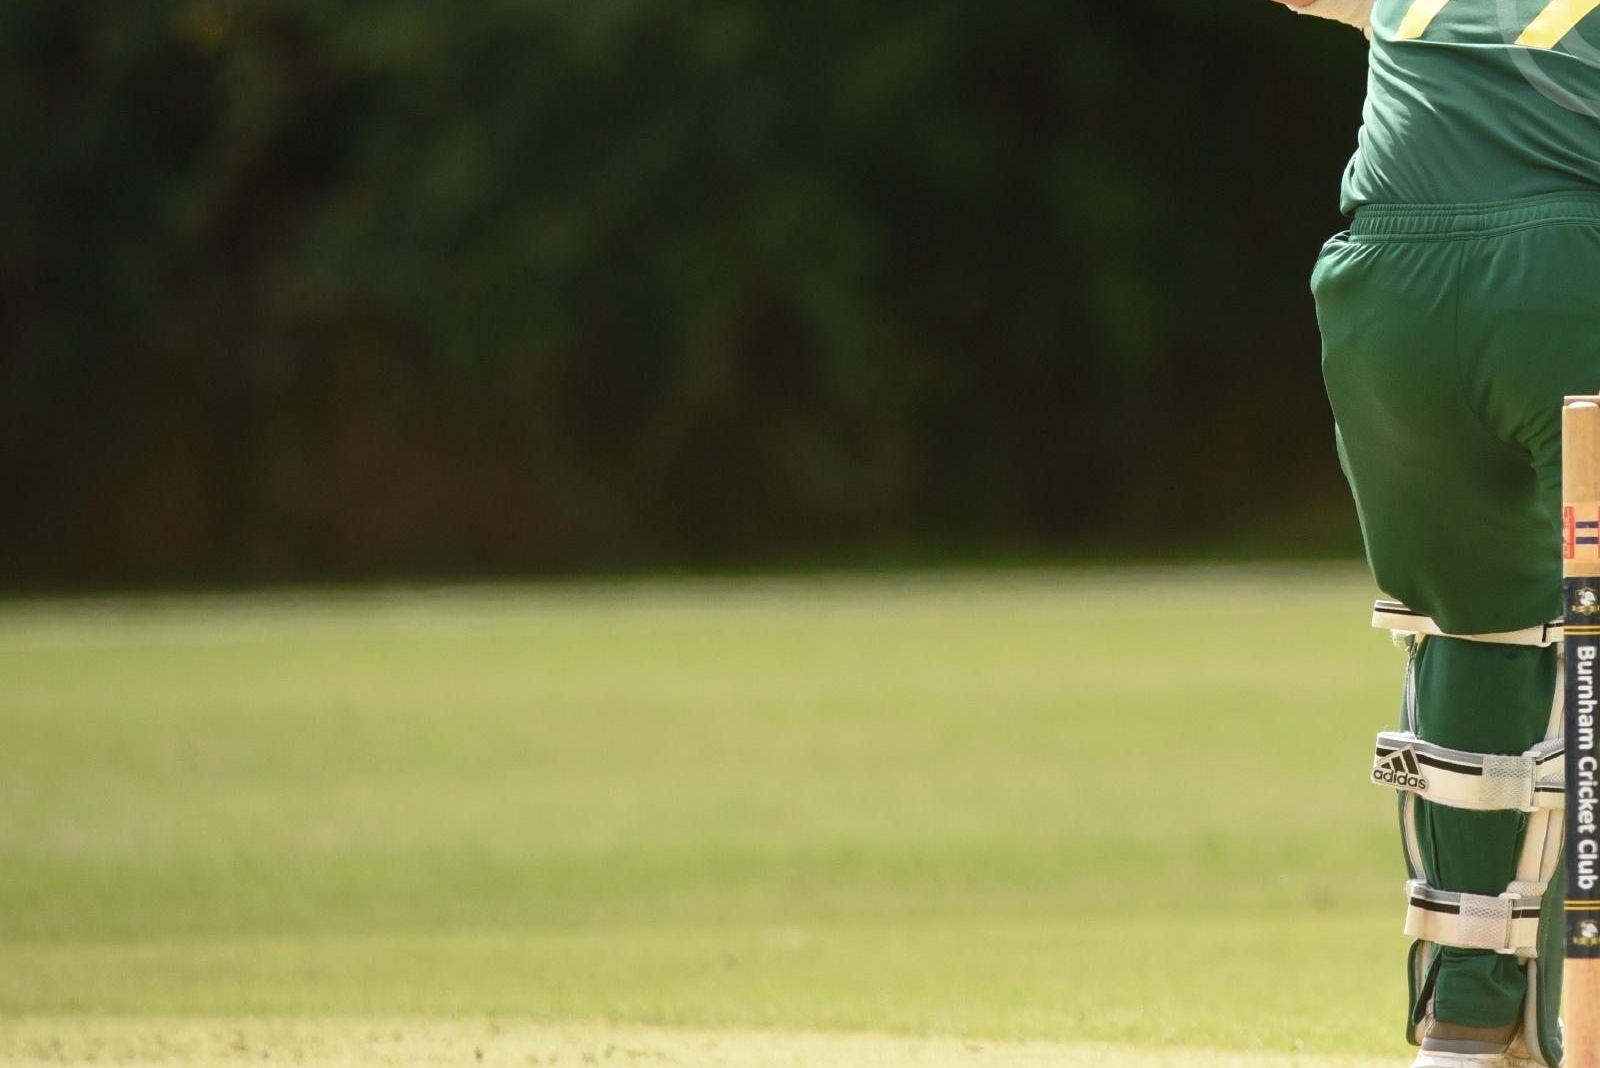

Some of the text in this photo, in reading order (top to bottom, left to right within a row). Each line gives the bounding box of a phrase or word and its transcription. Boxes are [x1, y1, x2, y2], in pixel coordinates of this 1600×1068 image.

[1373, 769, 1426, 790] adidas
[1576, 645, 1599, 890] Burnham Cricket Club
